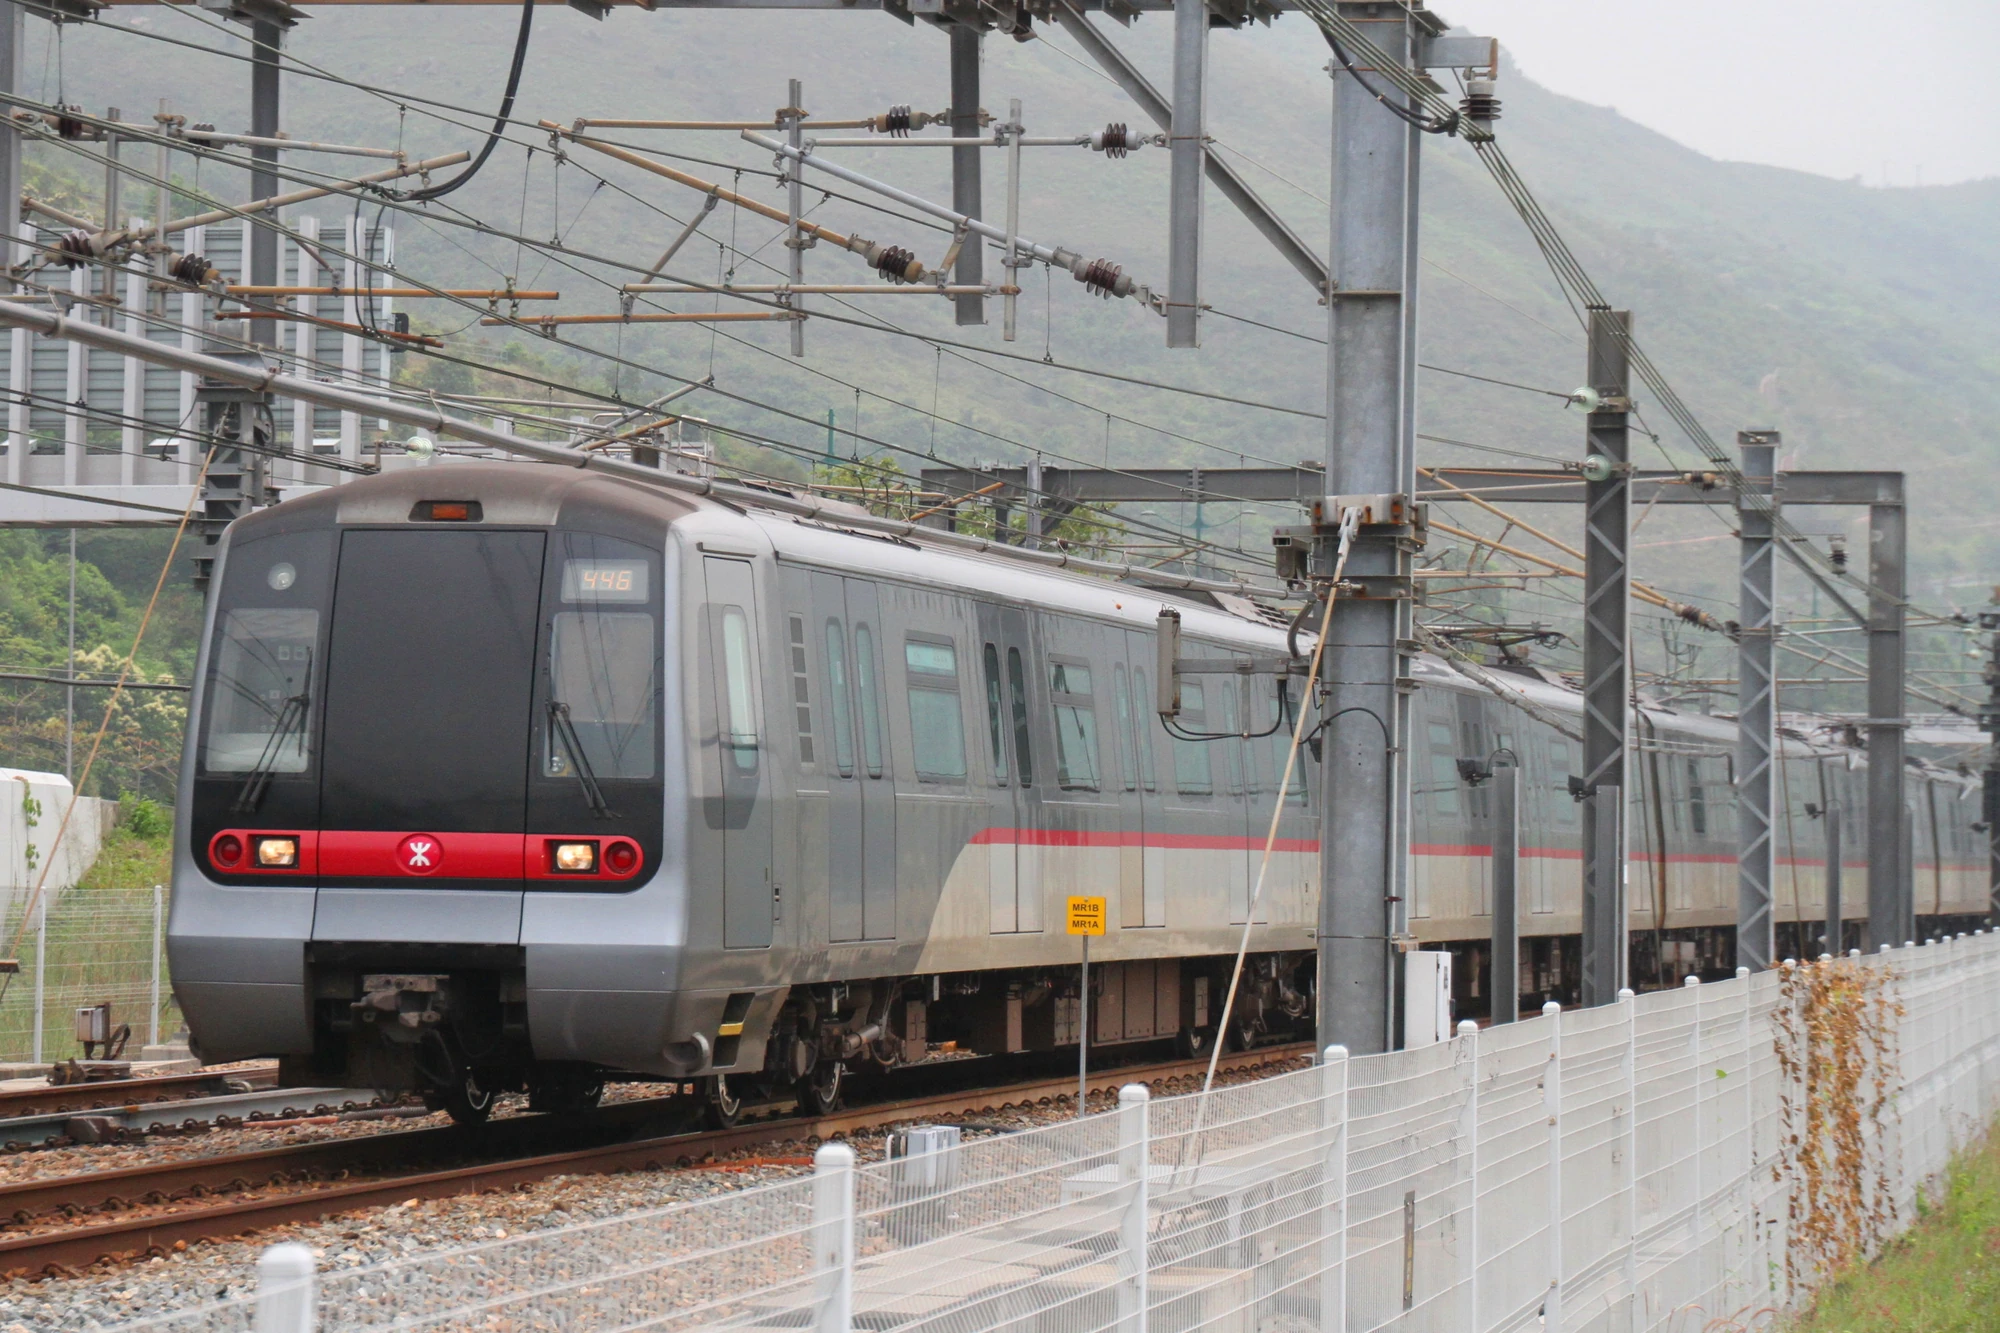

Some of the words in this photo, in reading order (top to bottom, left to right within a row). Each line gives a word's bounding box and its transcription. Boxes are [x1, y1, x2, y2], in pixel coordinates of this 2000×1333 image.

[583, 570, 632, 591] 446
[1072, 903, 1099, 912] MR1B
[1072, 920, 1099, 928] MR1A
